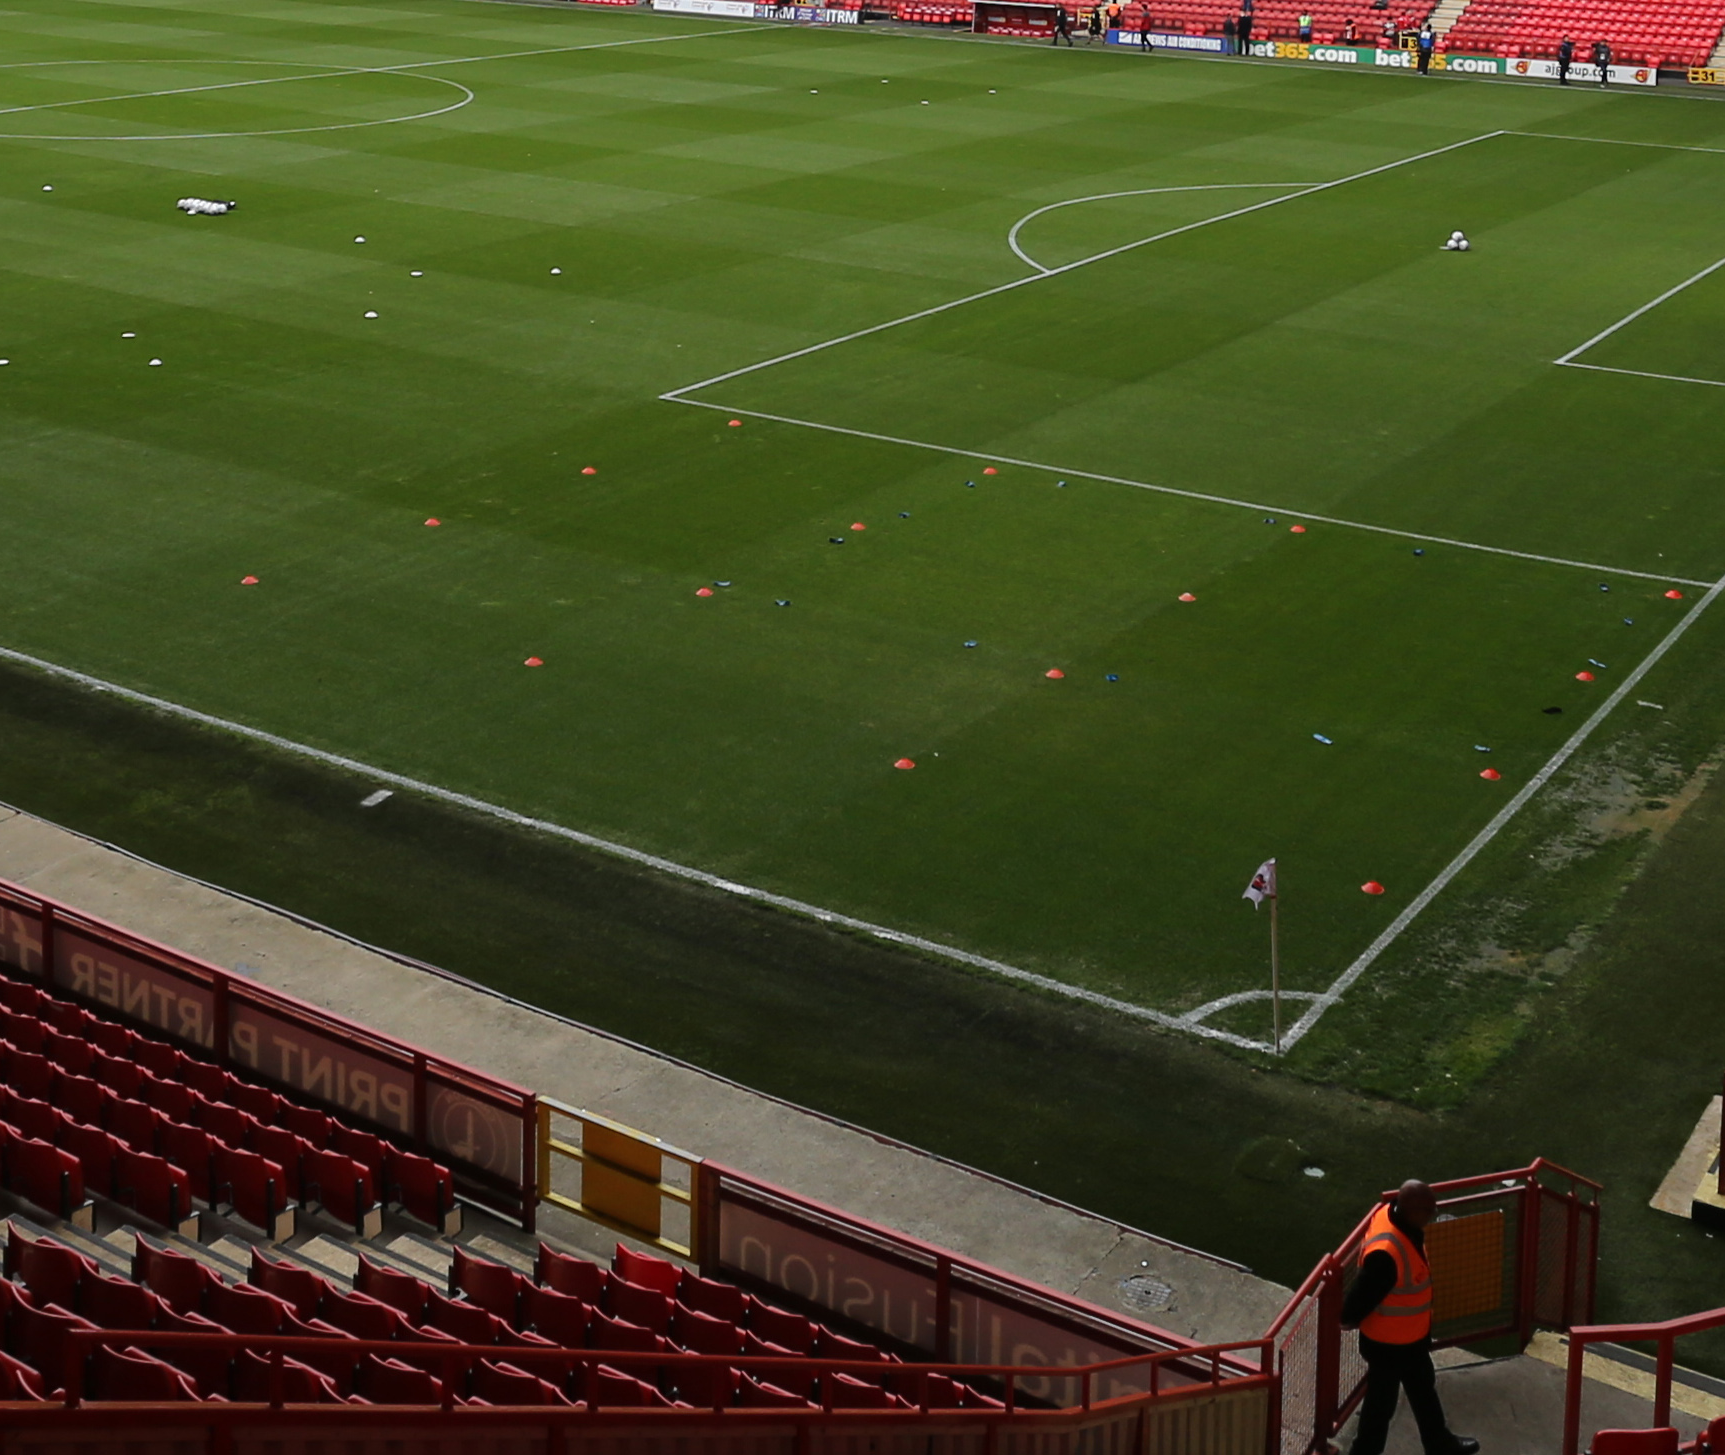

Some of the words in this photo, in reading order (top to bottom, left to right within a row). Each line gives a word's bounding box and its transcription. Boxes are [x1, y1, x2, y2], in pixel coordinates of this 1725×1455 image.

[826, 9, 859, 24] ITRM
[1167, 34, 1178, 47] AIR
[1178, 35, 1221, 51] CONDITIONING
[1701, 71, 1715, 83] 31
